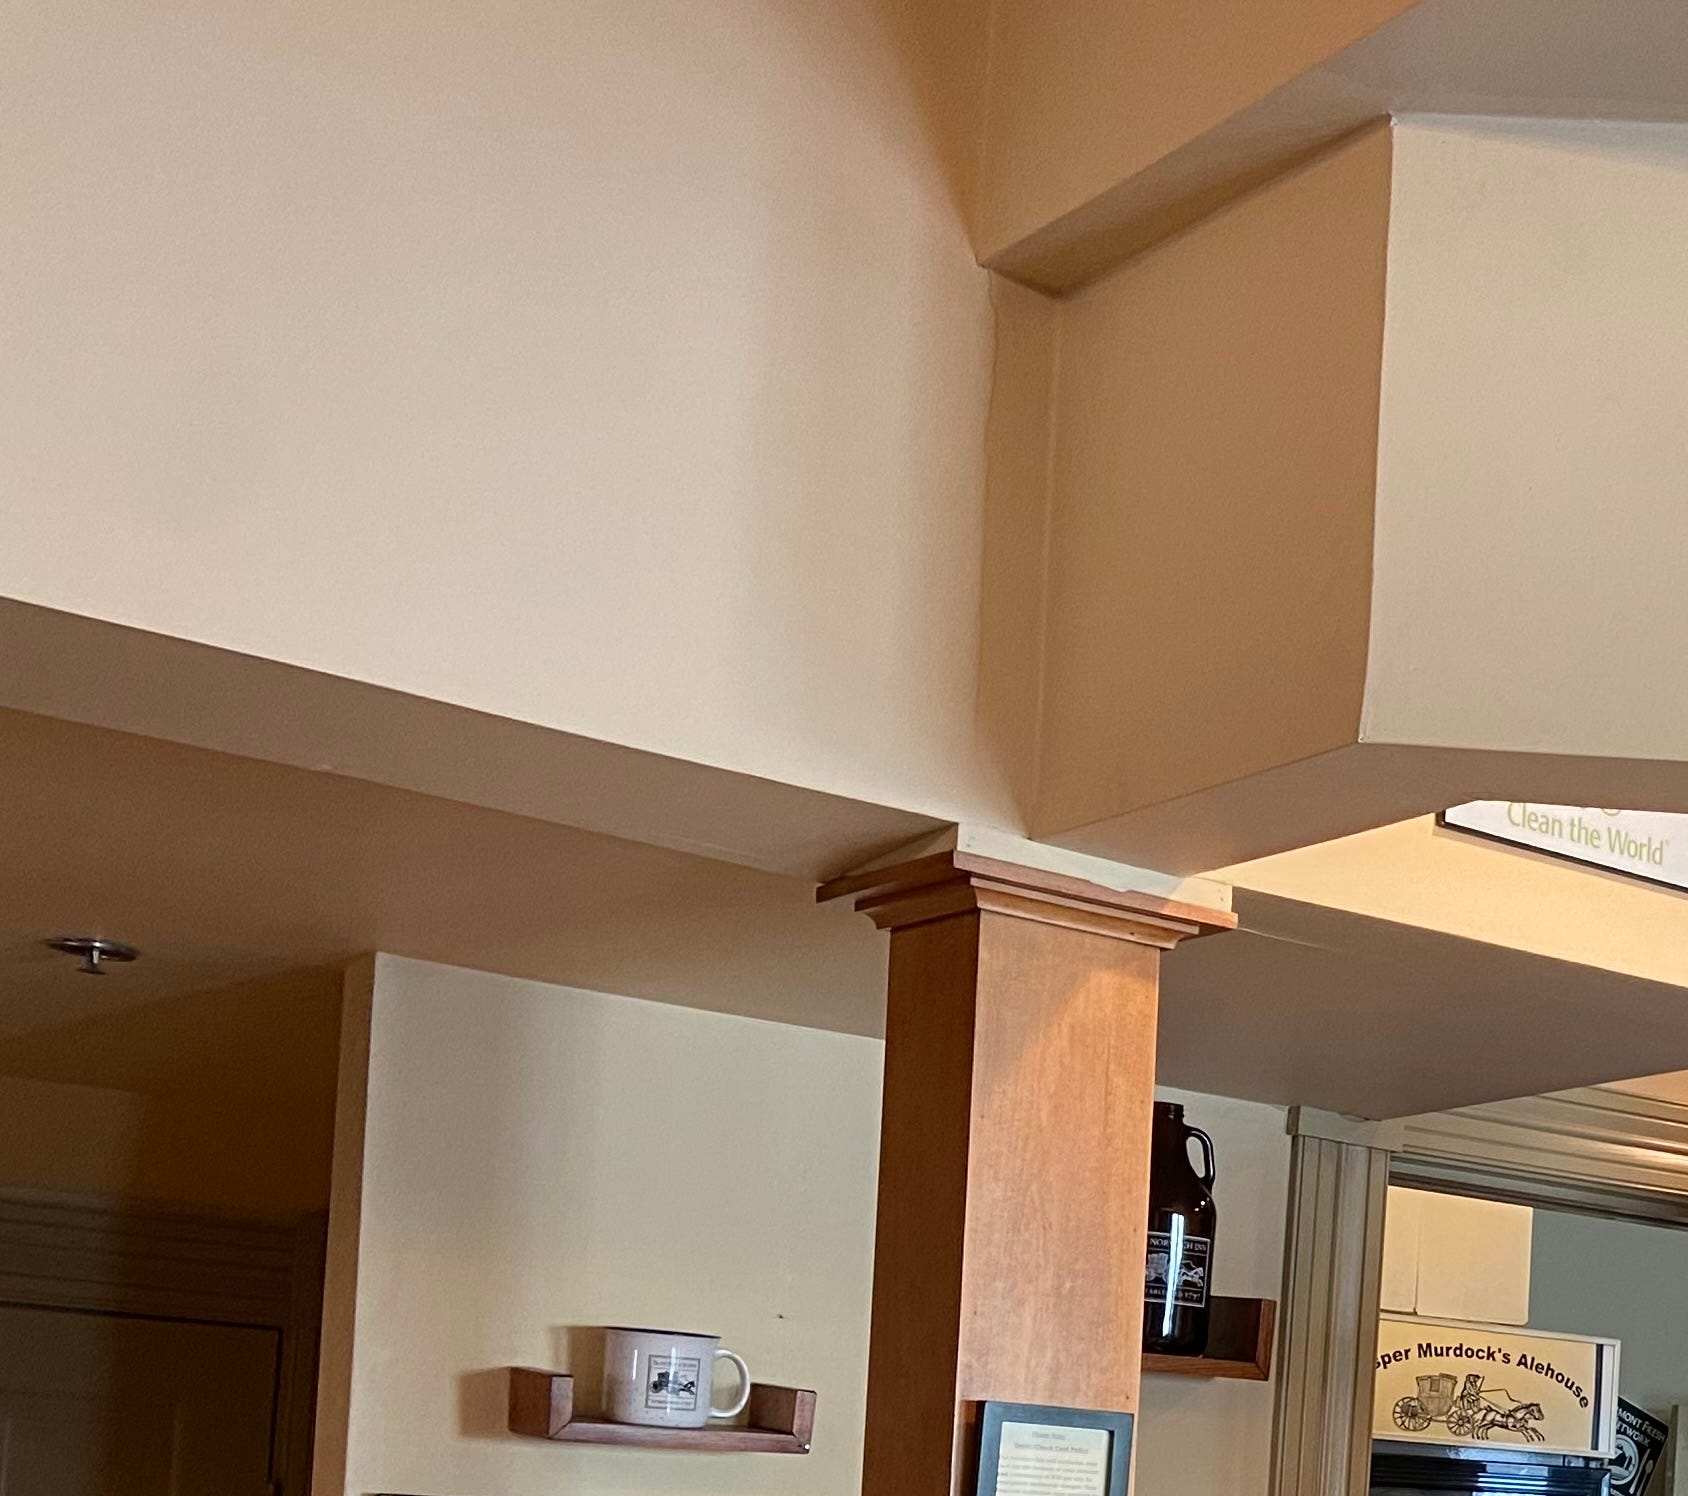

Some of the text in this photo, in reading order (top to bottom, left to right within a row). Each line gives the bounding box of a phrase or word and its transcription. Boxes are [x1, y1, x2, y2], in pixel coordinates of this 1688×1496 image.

[1507, 801, 1554, 839] Clean
[1569, 816, 1602, 849] the
[1417, 1342, 1512, 1365] Murdock's
[1516, 1353, 1590, 1409] Alehouse
[1617, 1407, 1643, 1429] MONT
